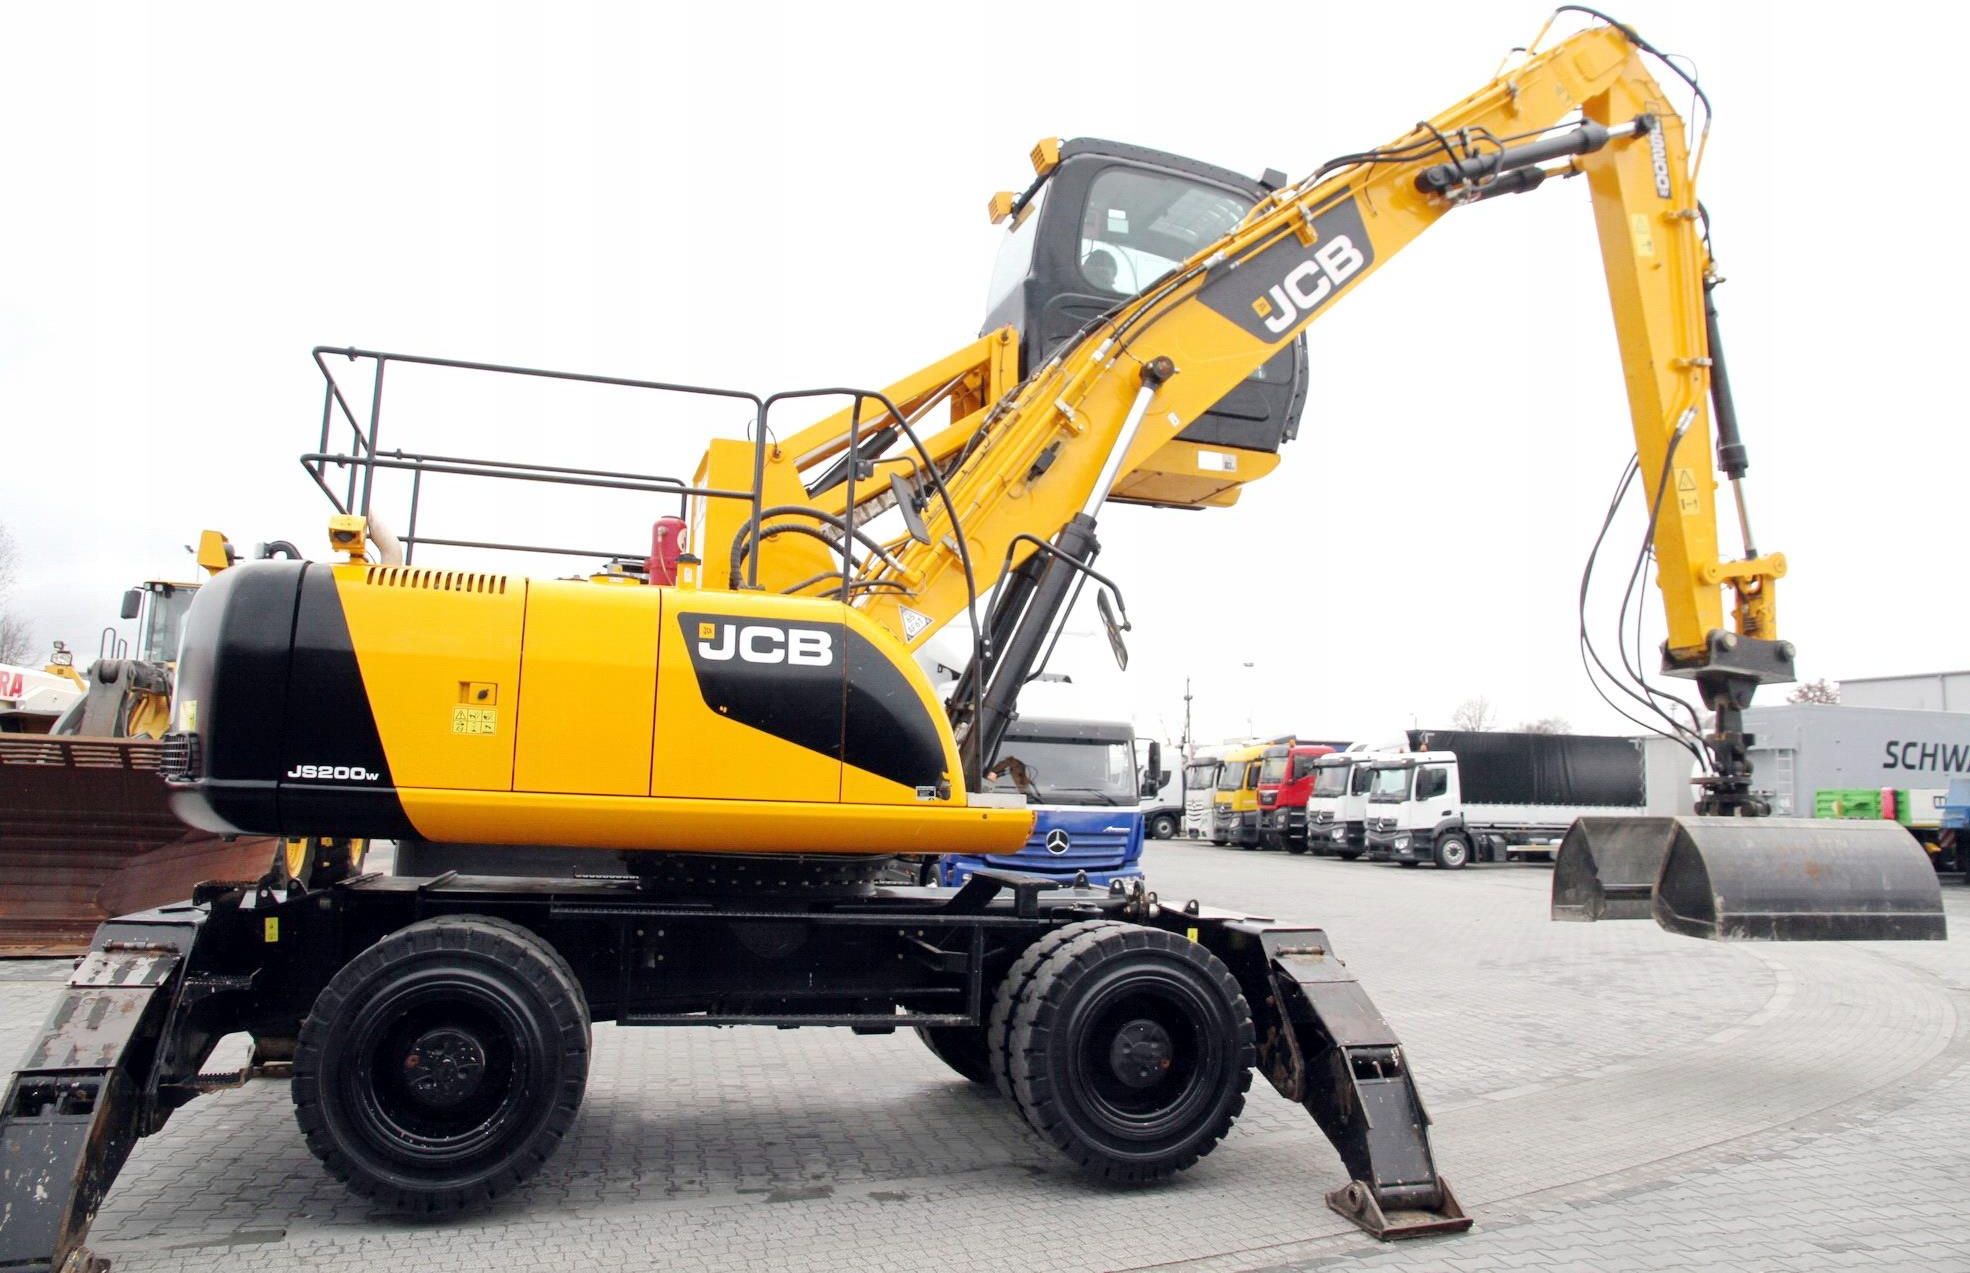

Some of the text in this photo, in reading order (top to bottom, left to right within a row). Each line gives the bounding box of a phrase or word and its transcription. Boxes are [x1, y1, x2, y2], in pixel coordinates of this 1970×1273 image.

[1264, 235, 1365, 333] JCB
[698, 624, 833, 666] JCB
[1883, 740, 1970, 773] SCHW
